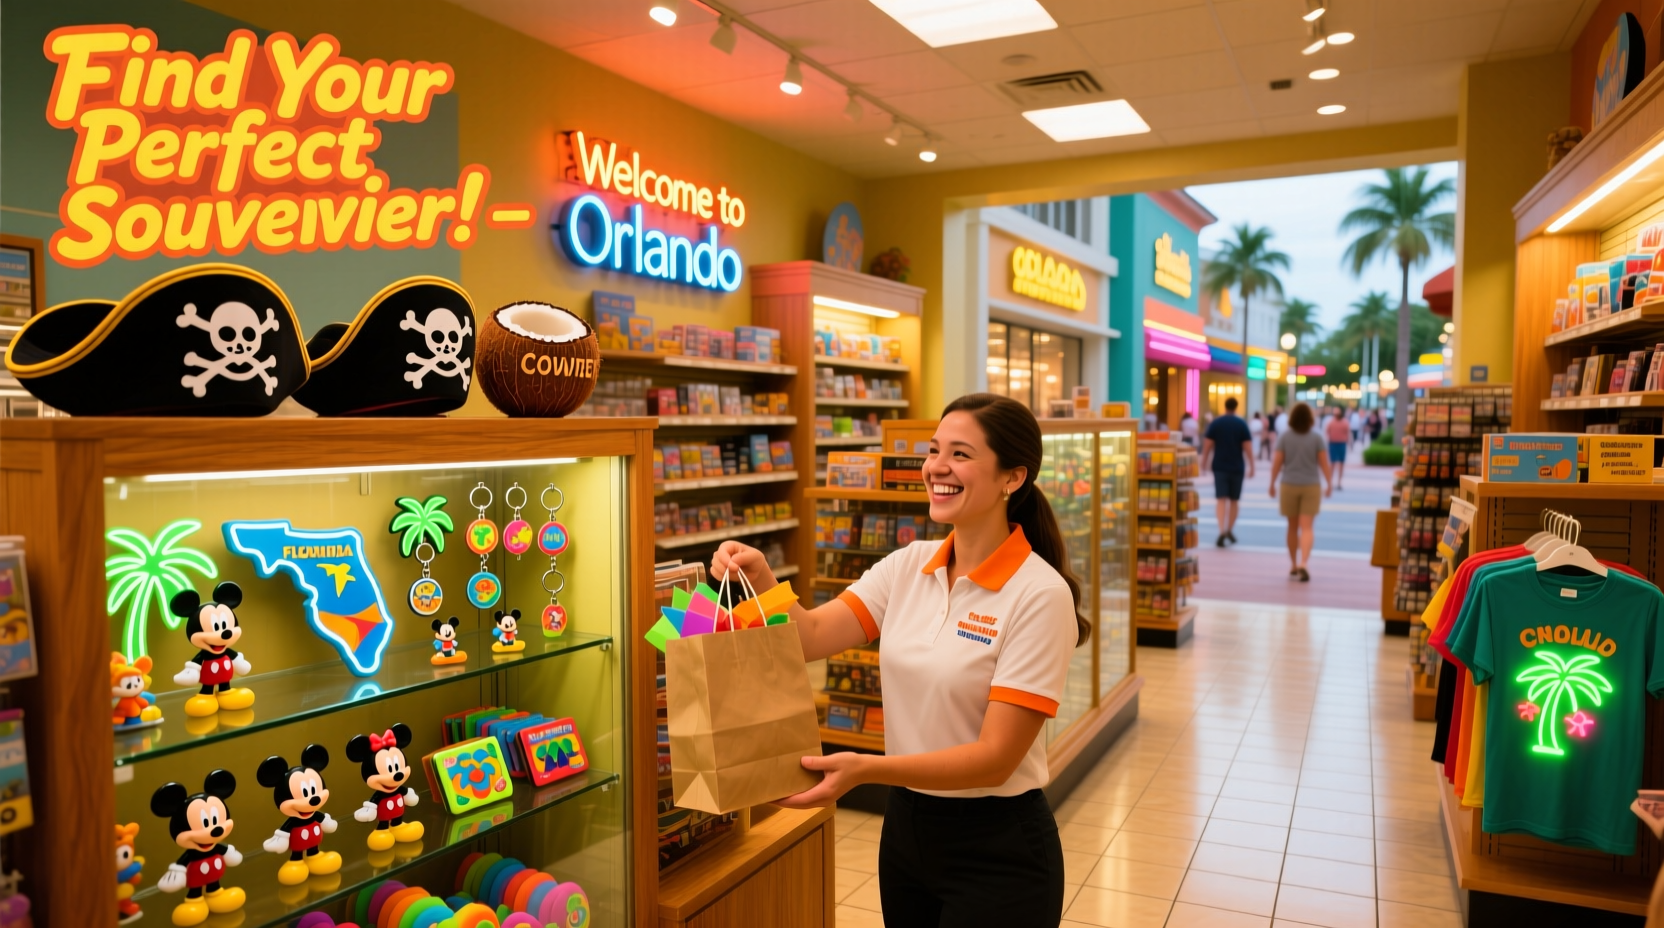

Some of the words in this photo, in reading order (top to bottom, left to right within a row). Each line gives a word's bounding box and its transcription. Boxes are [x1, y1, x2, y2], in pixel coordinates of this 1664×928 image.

[576, 130, 714, 219] Welcome
[716, 186, 746, 228] to
[569, 194, 743, 293] Orlando
